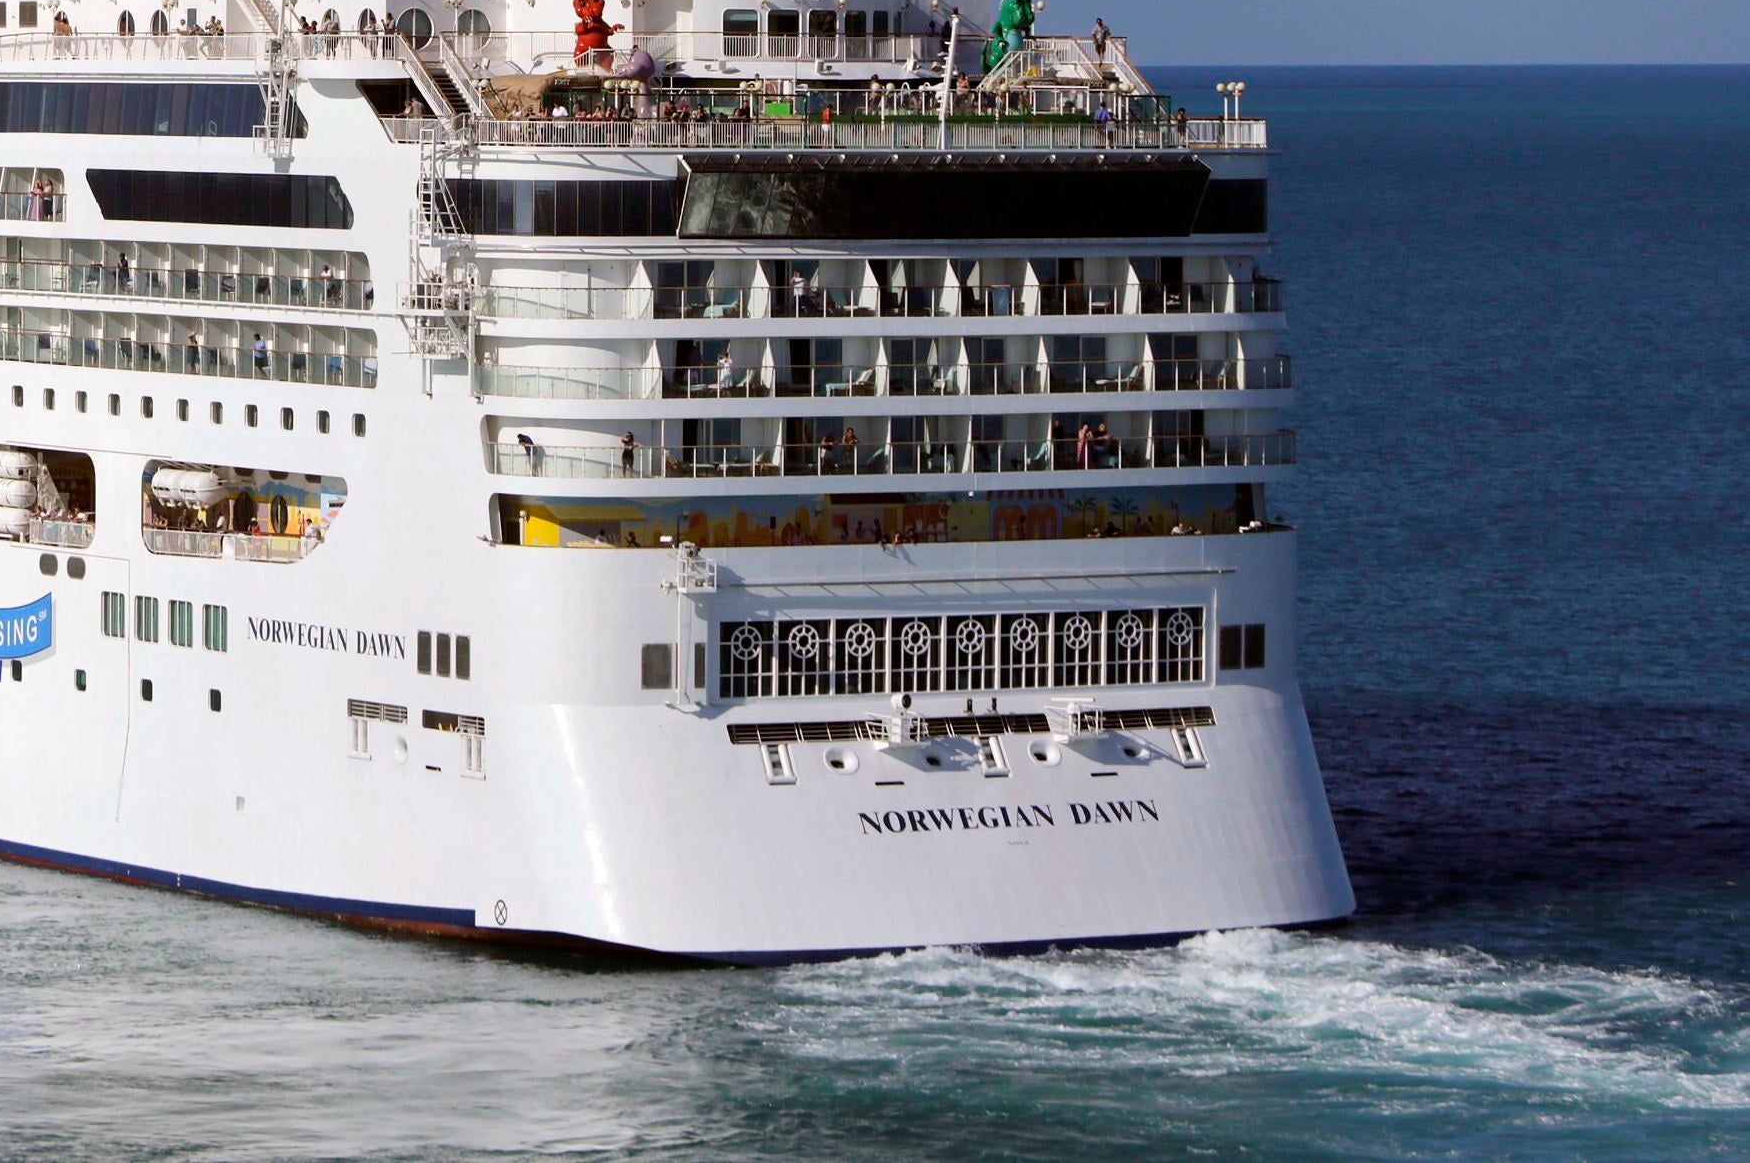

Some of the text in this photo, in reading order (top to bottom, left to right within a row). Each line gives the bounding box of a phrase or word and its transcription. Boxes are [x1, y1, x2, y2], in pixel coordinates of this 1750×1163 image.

[247, 616, 406, 660] NORWEGIAN DAWN
[857, 798, 1160, 836] NORWEGIAN DAWN
